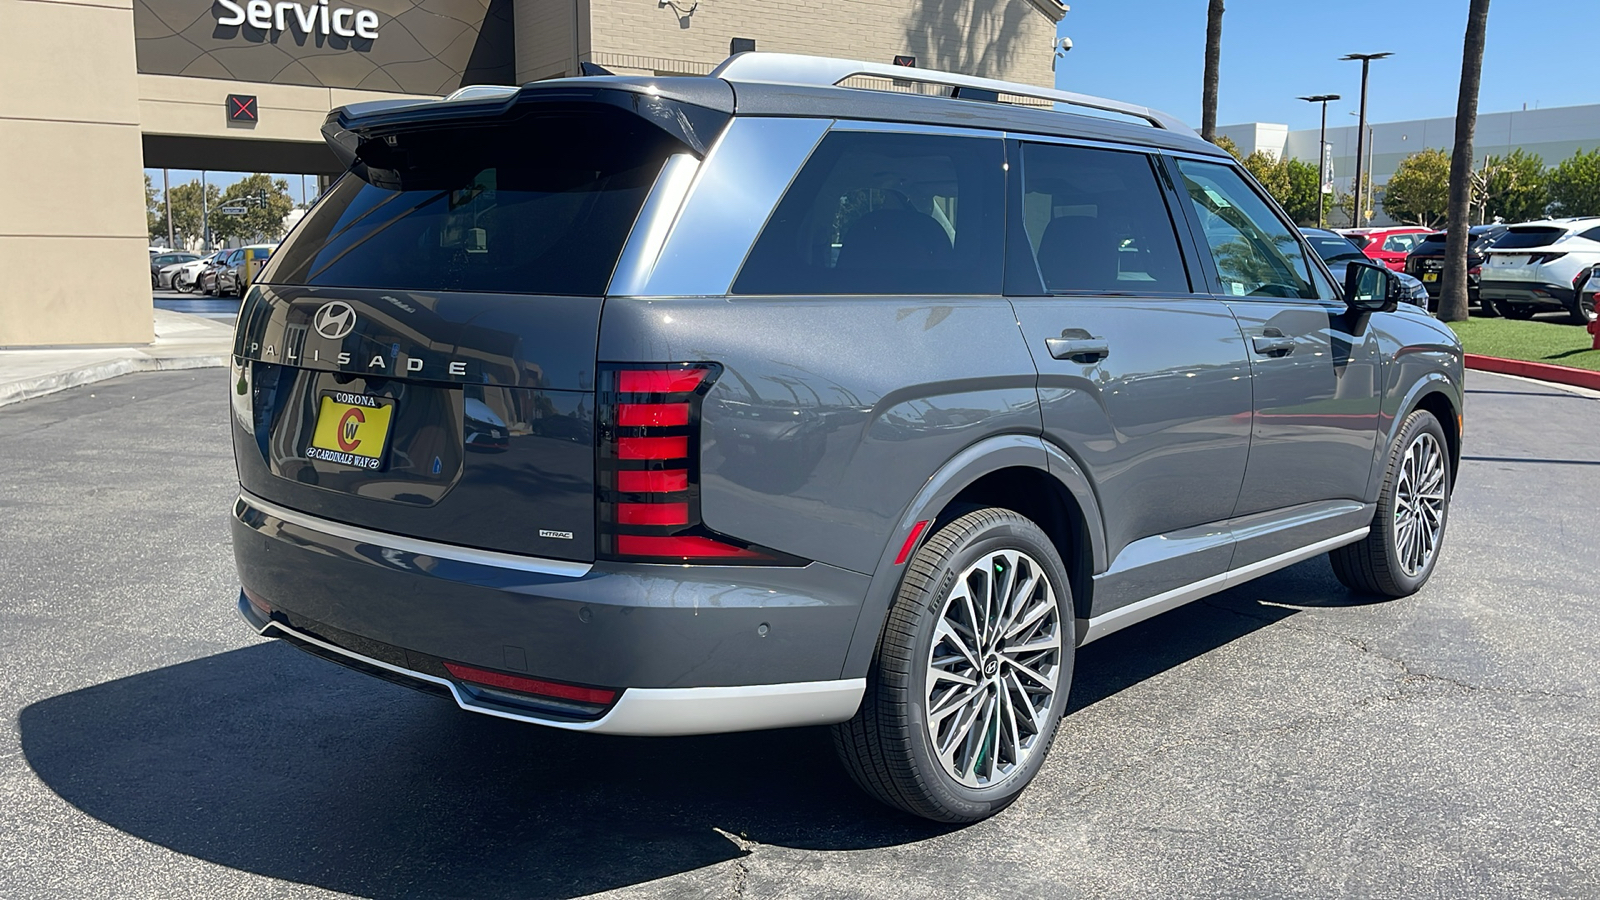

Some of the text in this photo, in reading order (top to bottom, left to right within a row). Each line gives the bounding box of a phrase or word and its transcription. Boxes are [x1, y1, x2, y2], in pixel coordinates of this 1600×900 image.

[218, 0, 379, 39] Service
[251, 342, 468, 376] PALISADE
[336, 392, 376, 407] CORONA
[316, 449, 370, 468] CARDINALE WAY
